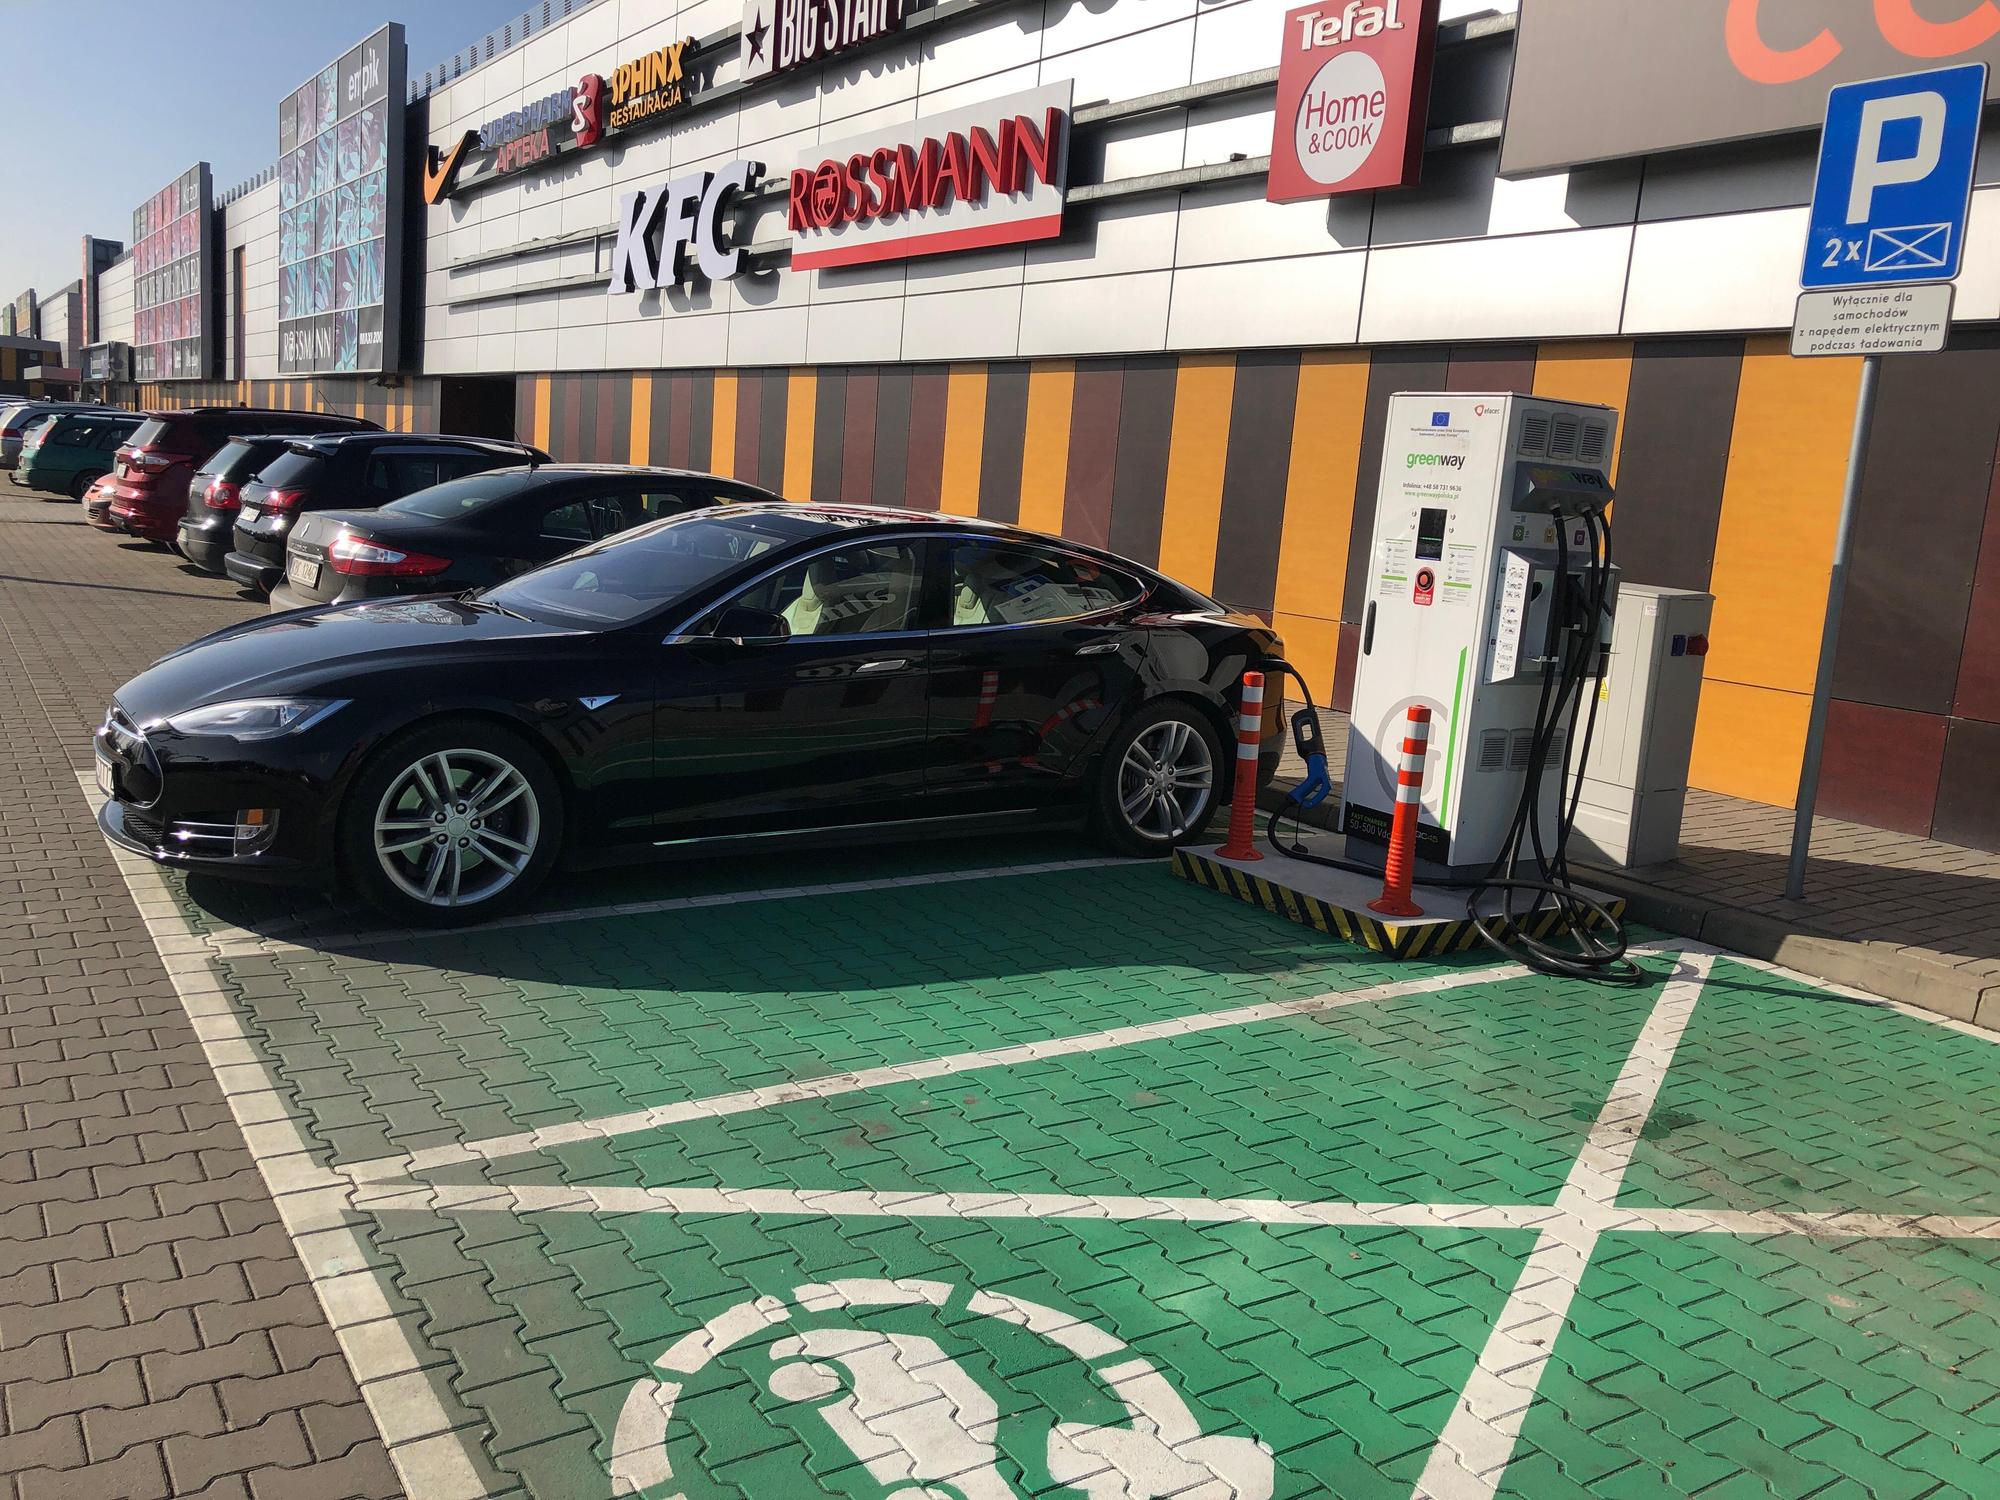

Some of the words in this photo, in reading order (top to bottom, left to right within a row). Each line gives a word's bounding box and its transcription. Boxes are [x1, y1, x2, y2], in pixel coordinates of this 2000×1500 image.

[1296, 0, 1404, 51] Tefal
[348, 48, 380, 102] empik
[611, 40, 684, 105] SPHINX
[610, 83, 682, 128] RESTAURACJA
[1305, 90, 1385, 130] Home
[496, 128, 550, 175] APTEKA
[788, 106, 1062, 231] ROSSMANN
[1846, 91, 1947, 225] P
[608, 160, 751, 294] KFC
[1832, 308, 1908, 321] samochodów
[1833, 293, 1890, 309] Wyłącznie
[1894, 291, 1913, 302] dla
[1808, 325, 1860, 339] napędem
[1864, 322, 1940, 335] elektrycznym
[1810, 339, 1855, 353] podczas
[1860, 337, 1923, 350] ładowania
[1407, 453, 1466, 471] greenway
